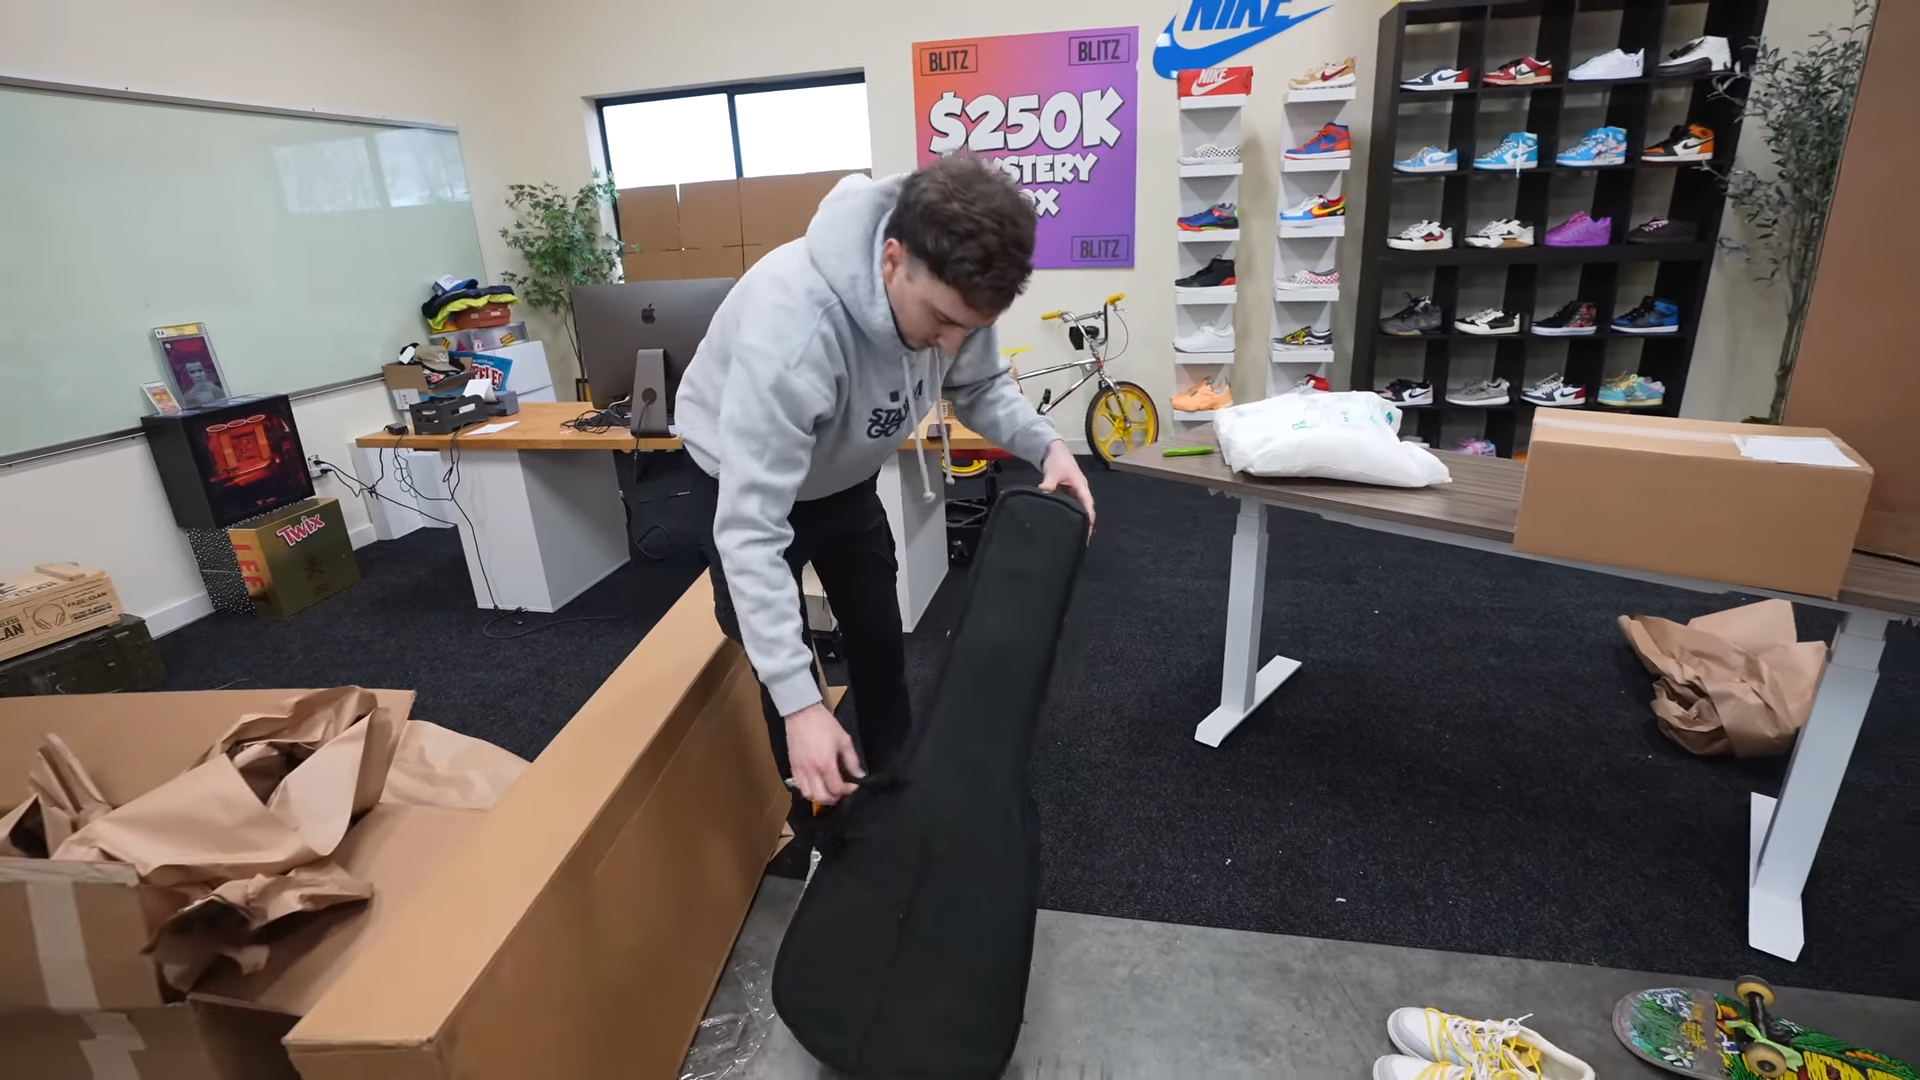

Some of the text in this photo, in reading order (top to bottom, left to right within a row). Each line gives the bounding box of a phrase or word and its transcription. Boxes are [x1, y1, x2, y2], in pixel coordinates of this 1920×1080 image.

[929, 49, 969, 72] BLITZ
[1078, 39, 1120, 62] BLITZ
[1197, 68, 1229, 84] NIKE
[929, 87, 1125, 153] $250K
[978, 152, 1099, 184] YSTERY
[1079, 239, 1120, 259] BLITZ
[276, 513, 325, 546] Twix
[88, 592, 107, 601] CLAN
[0, 623, 25, 640] AN
